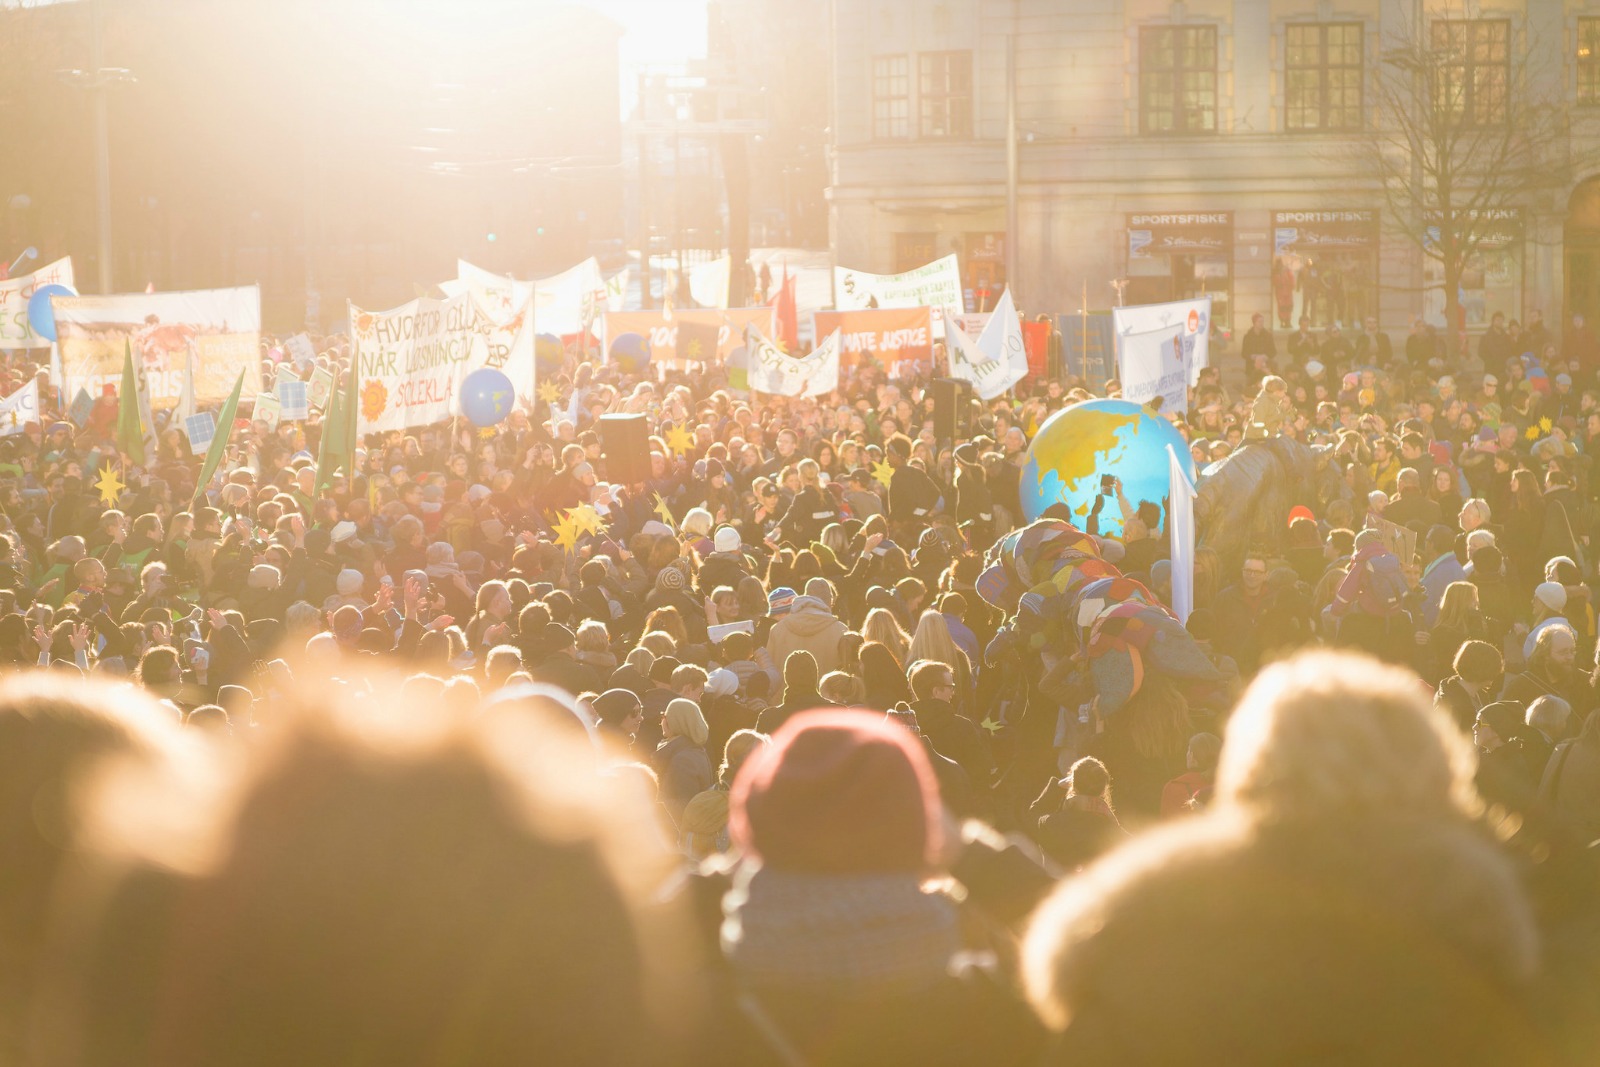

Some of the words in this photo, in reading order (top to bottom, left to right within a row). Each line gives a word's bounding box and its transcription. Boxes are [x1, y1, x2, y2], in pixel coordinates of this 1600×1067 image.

[1131, 213, 1228, 225] SPORTSFISKE
[1276, 211, 1371, 223] SPORTSFISKE
[375, 310, 440, 343] HVORFOR
[880, 327, 927, 351] JUSTICE
[360, 346, 398, 376] NÅR
[405, 336, 473, 374] LØSNINGN
